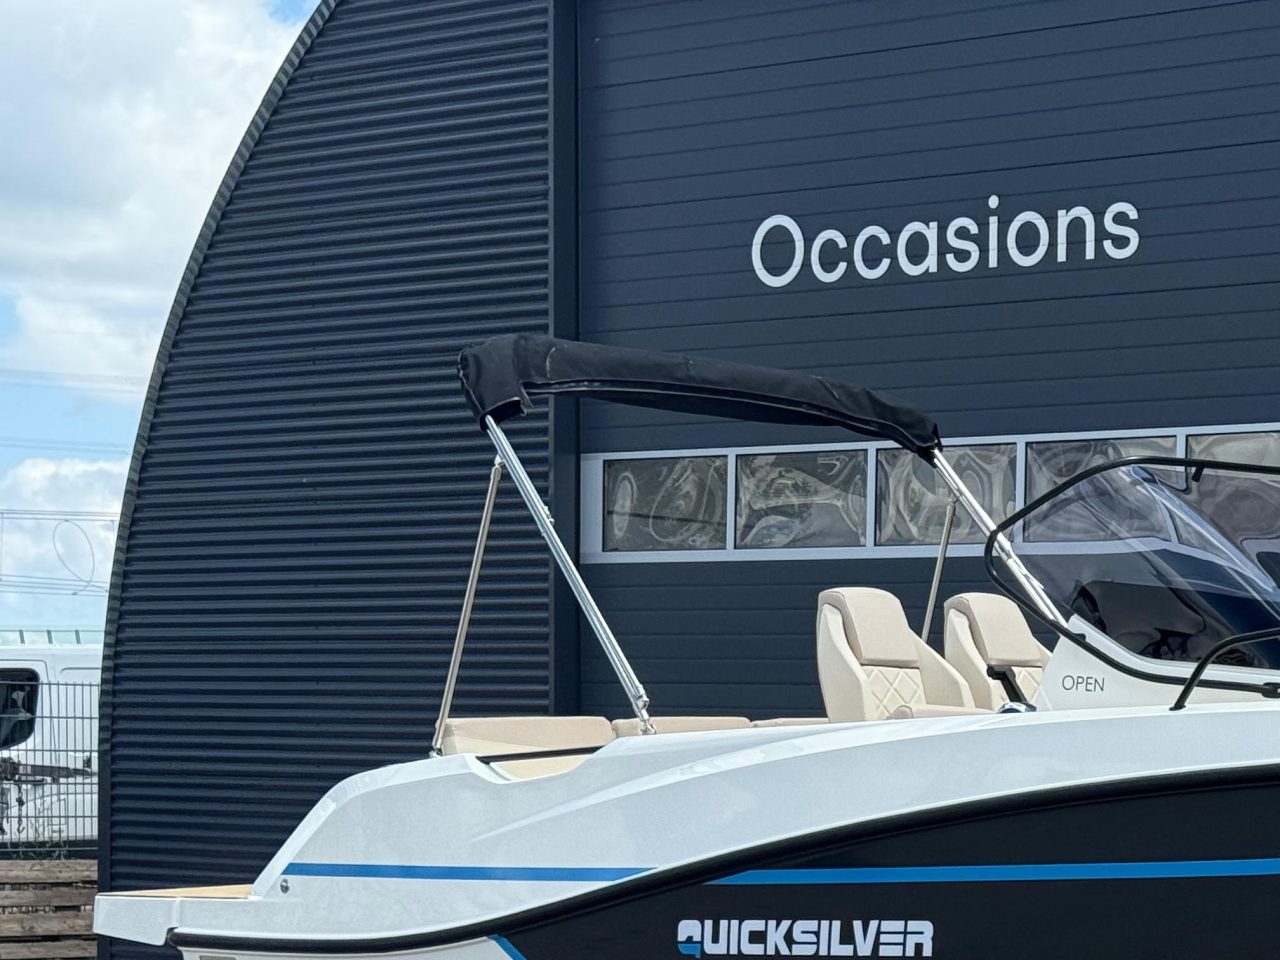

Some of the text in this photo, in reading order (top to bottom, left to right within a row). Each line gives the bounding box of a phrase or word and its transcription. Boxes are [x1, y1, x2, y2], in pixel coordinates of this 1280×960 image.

[751, 194, 1140, 288] Occasions
[1061, 674, 1105, 692] OPEN
[677, 919, 934, 958] QUICKSILVER
